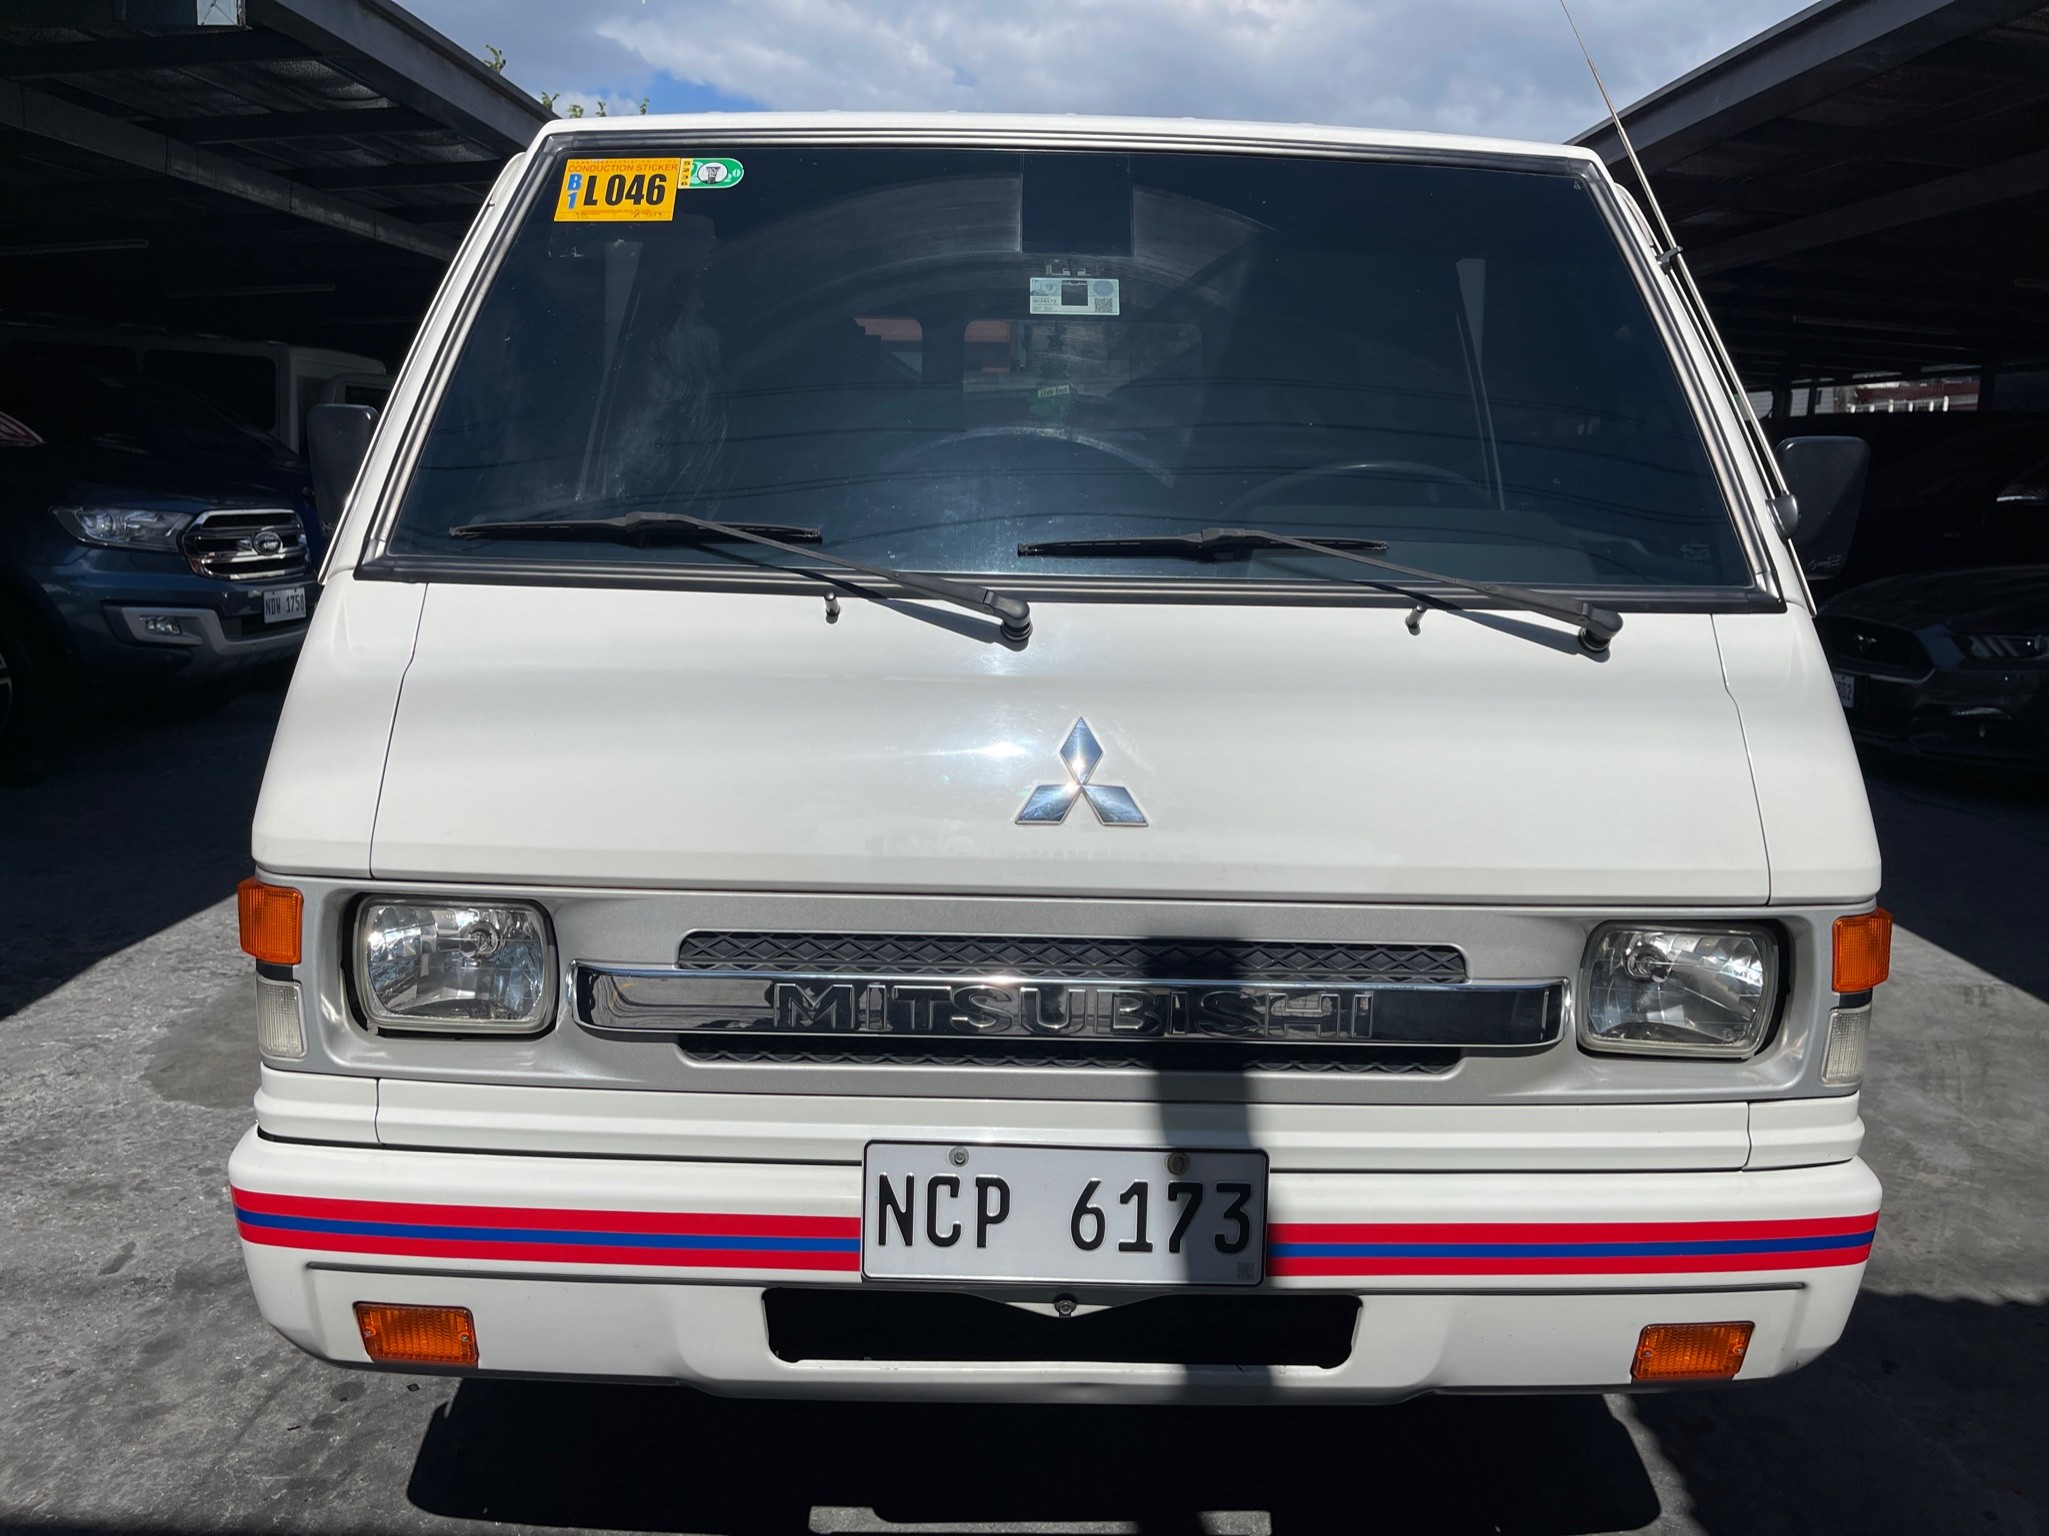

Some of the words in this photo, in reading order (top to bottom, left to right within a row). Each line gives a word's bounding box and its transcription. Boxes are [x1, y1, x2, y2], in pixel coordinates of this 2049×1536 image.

[568, 164, 634, 172] CONDUCTION
[636, 163, 678, 172] STICKER
[567, 173, 583, 191] B
[604, 173, 668, 206] 046
[567, 192, 577, 209] 1
[773, 982, 1375, 1039] MITSUBISHI
[877, 1172, 1011, 1249] NCP
[1069, 1177, 1252, 1254] 6173
